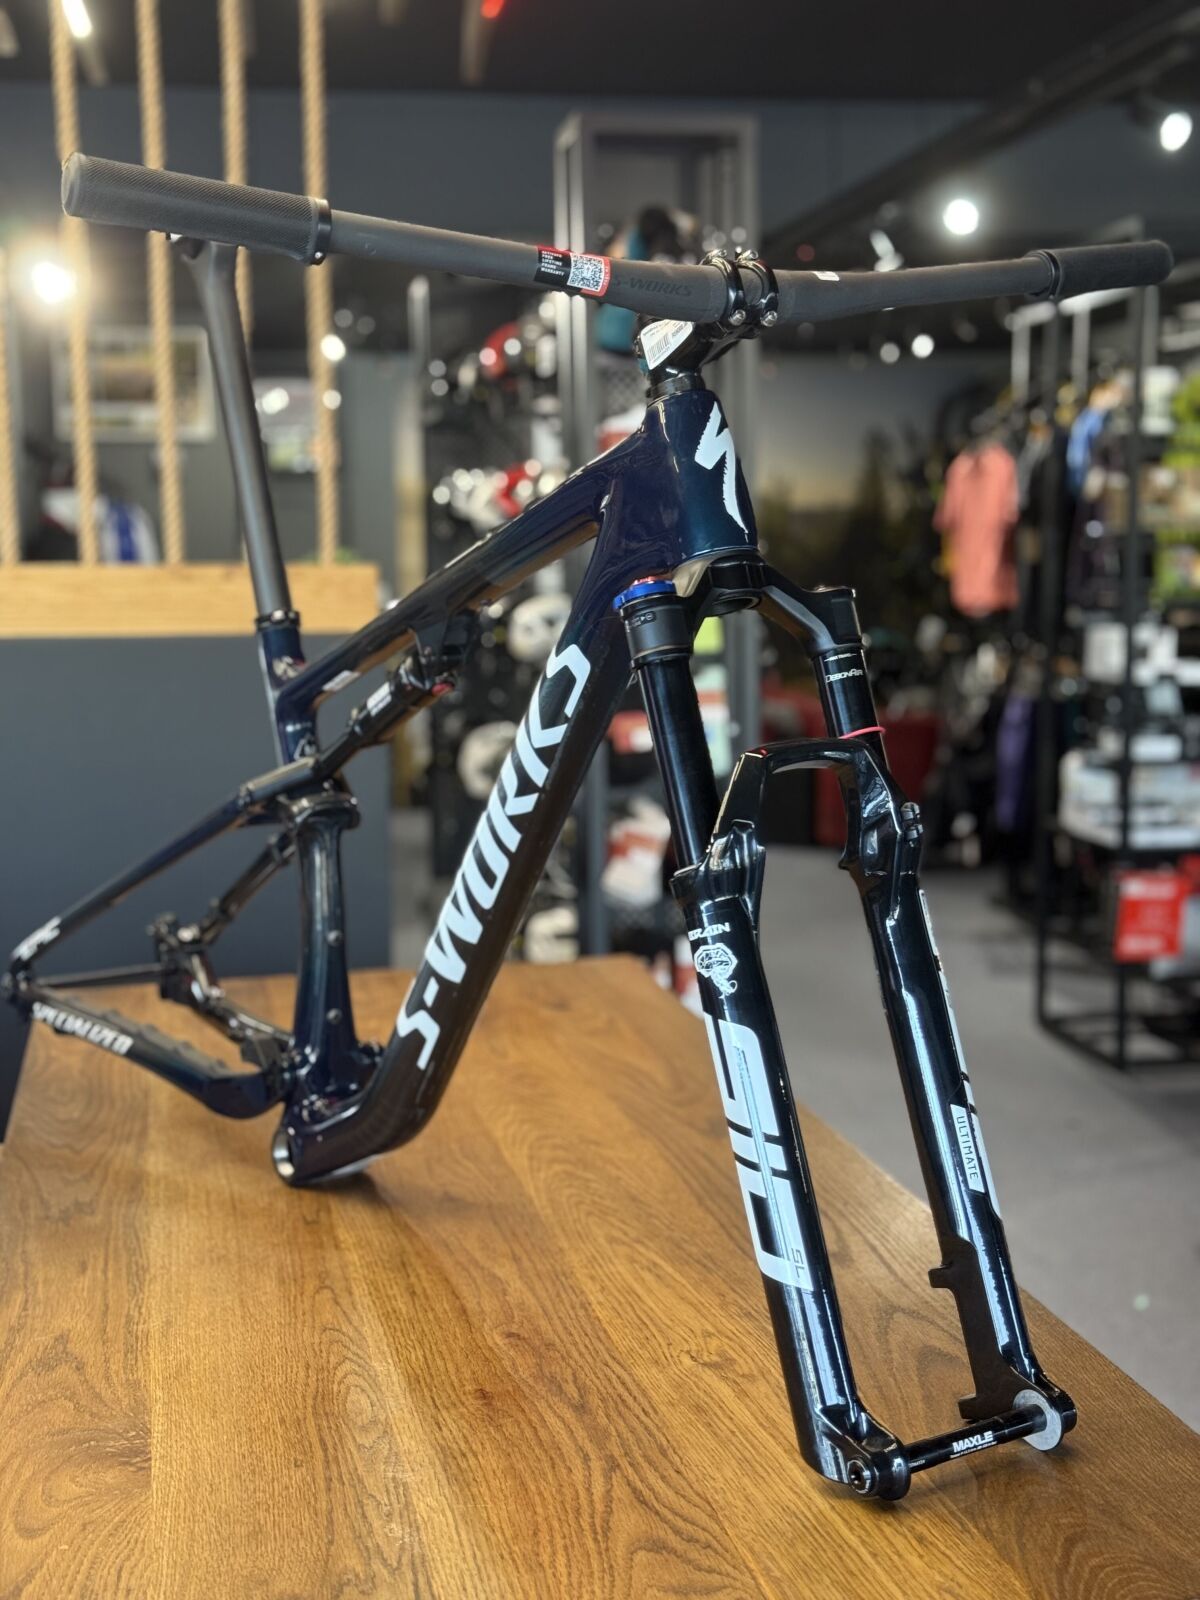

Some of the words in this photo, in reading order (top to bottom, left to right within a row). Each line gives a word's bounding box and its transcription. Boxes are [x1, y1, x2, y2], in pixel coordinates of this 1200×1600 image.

[397, 643, 591, 1070] S-WORKS
[956, 1115, 979, 1180] ULTIMATE
[790, 1247, 805, 1279] SL
[952, 1430, 994, 1453] MAXLE
